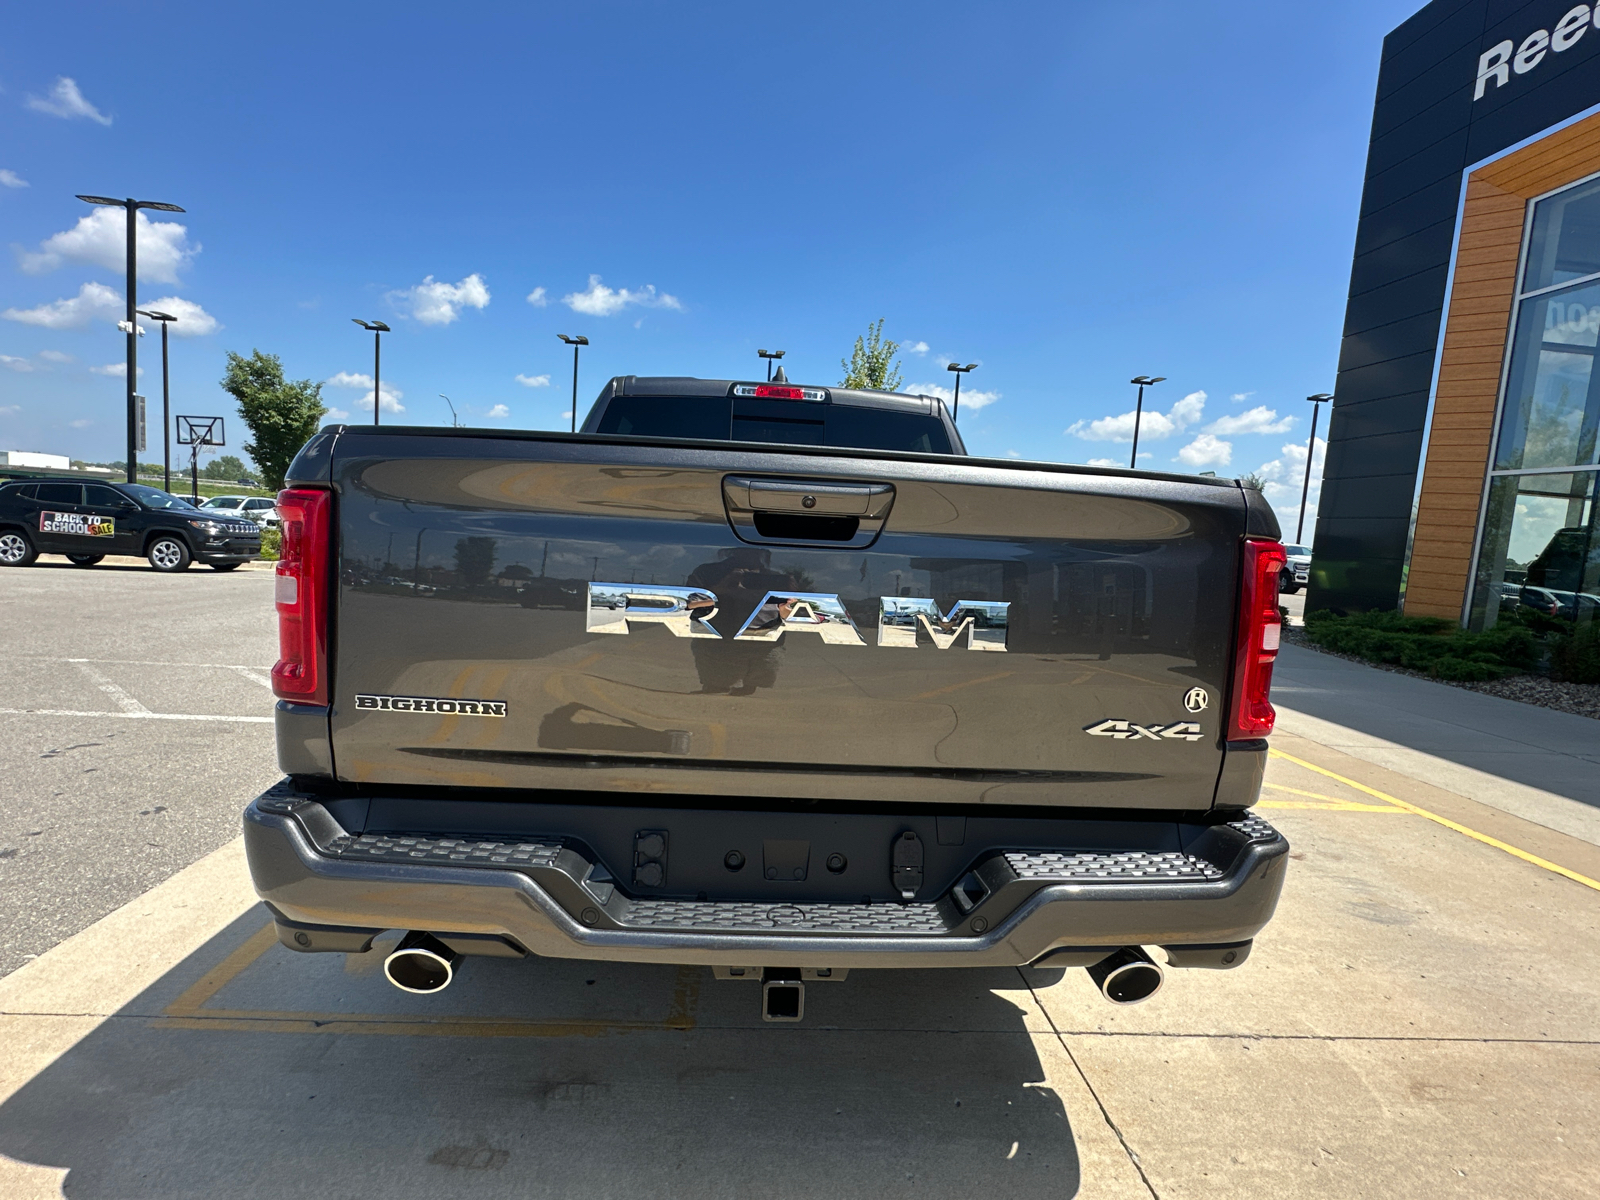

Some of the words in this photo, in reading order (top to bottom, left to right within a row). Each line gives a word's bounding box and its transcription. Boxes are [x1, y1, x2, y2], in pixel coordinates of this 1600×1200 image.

[1473, 0, 1600, 102] Ree
[43, 521, 91, 534] SCHOOL
[91, 524, 112, 535] SALE
[54, 513, 84, 524] BACK
[88, 516, 101, 525] TO
[586, 582, 1011, 651] RAM
[355, 694, 507, 718] BIGHORN
